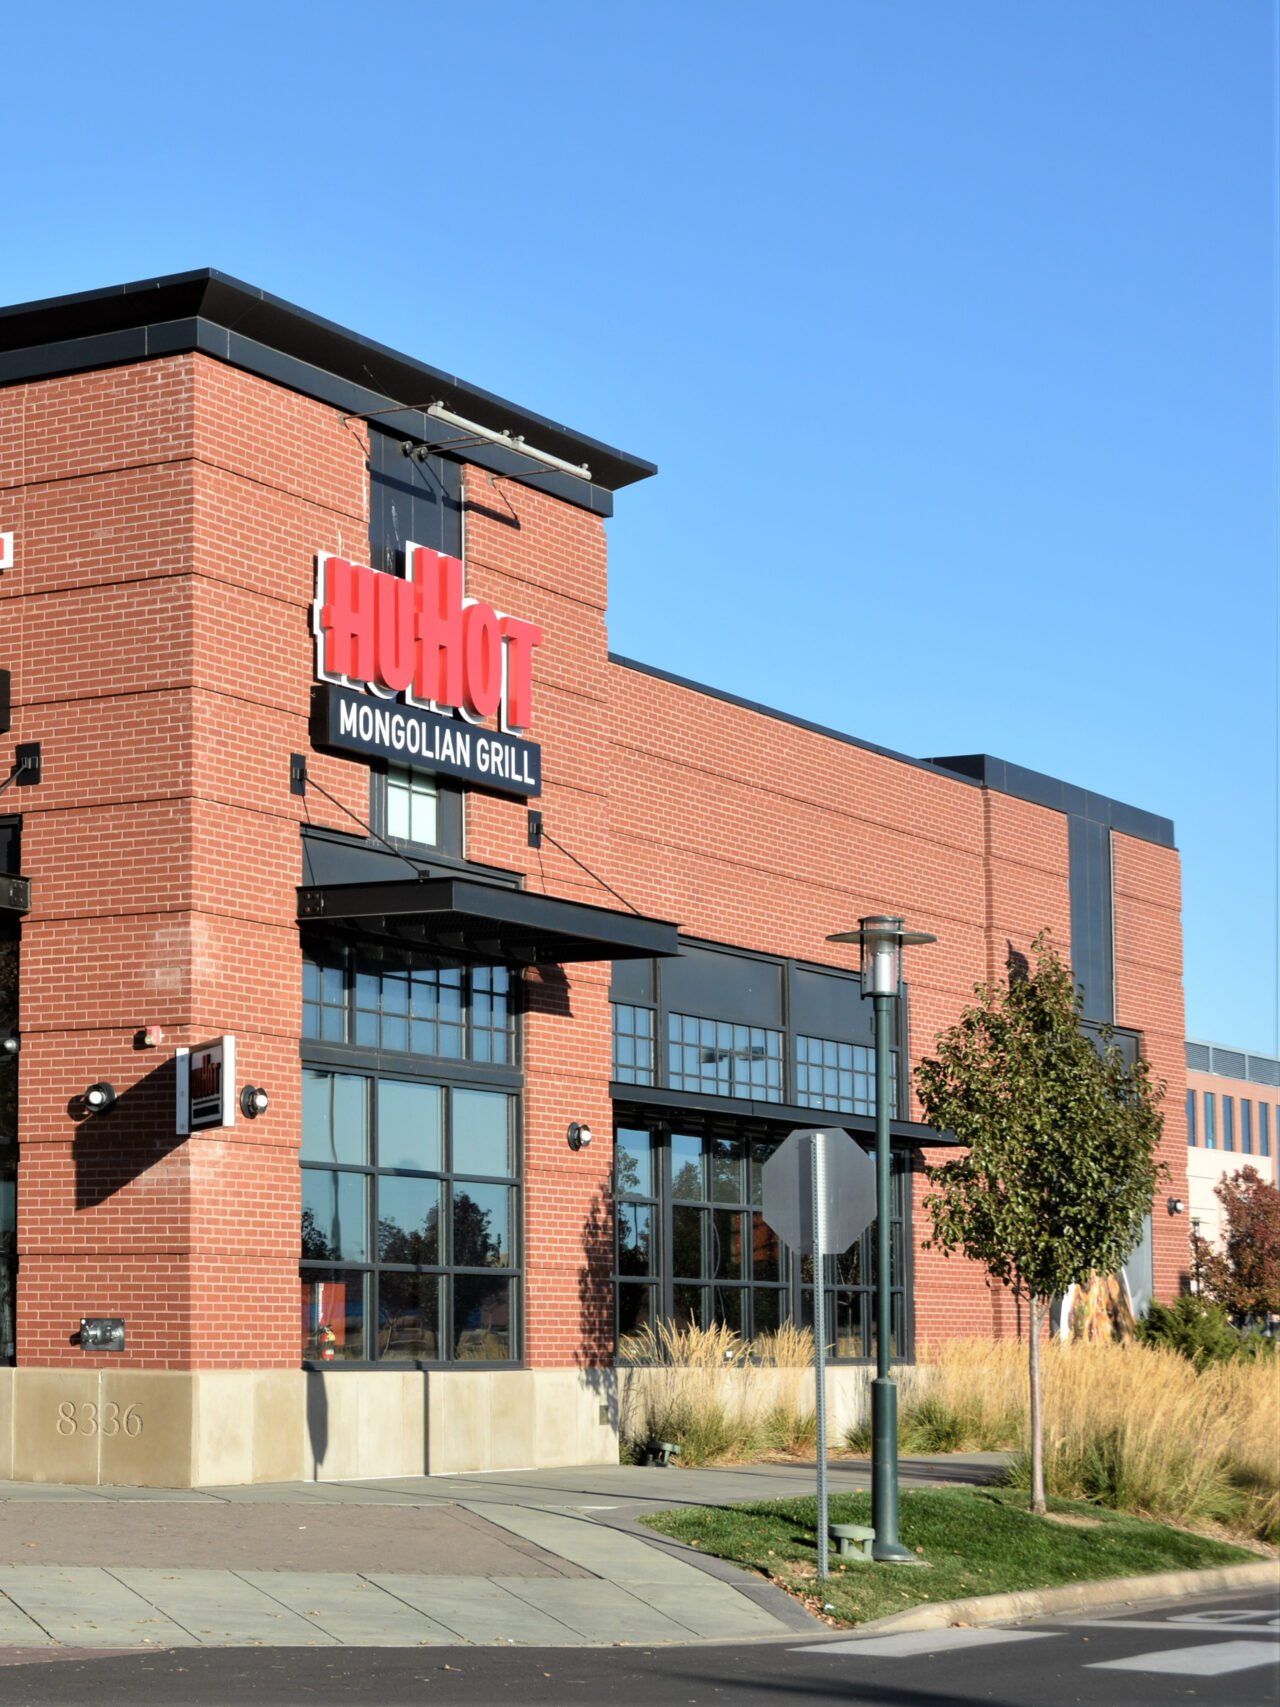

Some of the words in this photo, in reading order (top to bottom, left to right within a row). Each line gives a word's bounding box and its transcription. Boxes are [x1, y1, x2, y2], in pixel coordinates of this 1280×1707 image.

[339, 699, 471, 768] MONGOLIAN
[476, 738, 536, 785] GRILL
[56, 1401, 144, 1438] 8336
